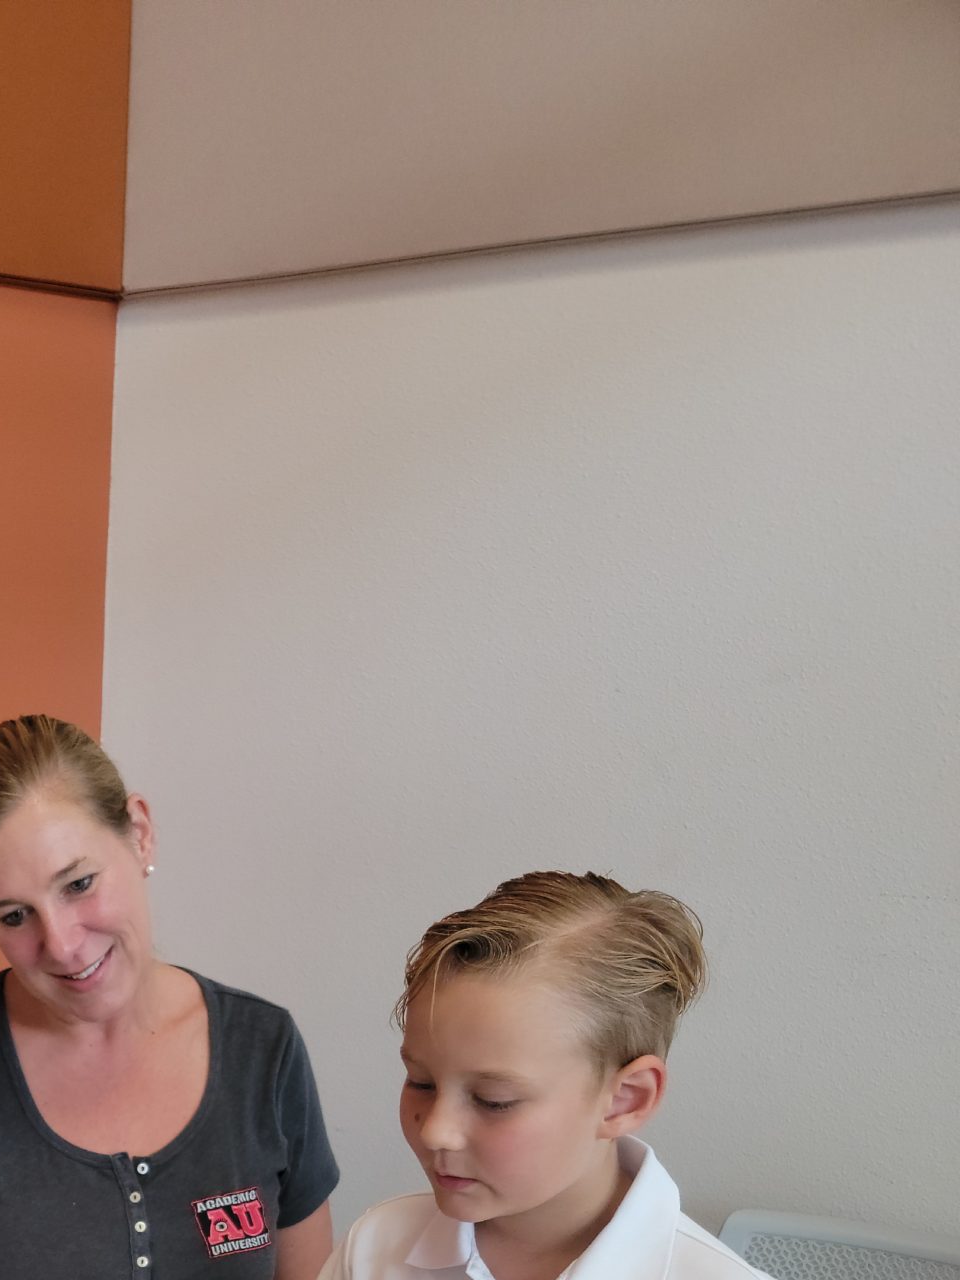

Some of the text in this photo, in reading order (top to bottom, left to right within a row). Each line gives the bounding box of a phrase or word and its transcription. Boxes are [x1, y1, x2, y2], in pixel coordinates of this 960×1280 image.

[197, 1190, 256, 1213] ACADEMIC
[207, 1200, 264, 1245] AU
[212, 1233, 269, 1255] UNIVERSITY
